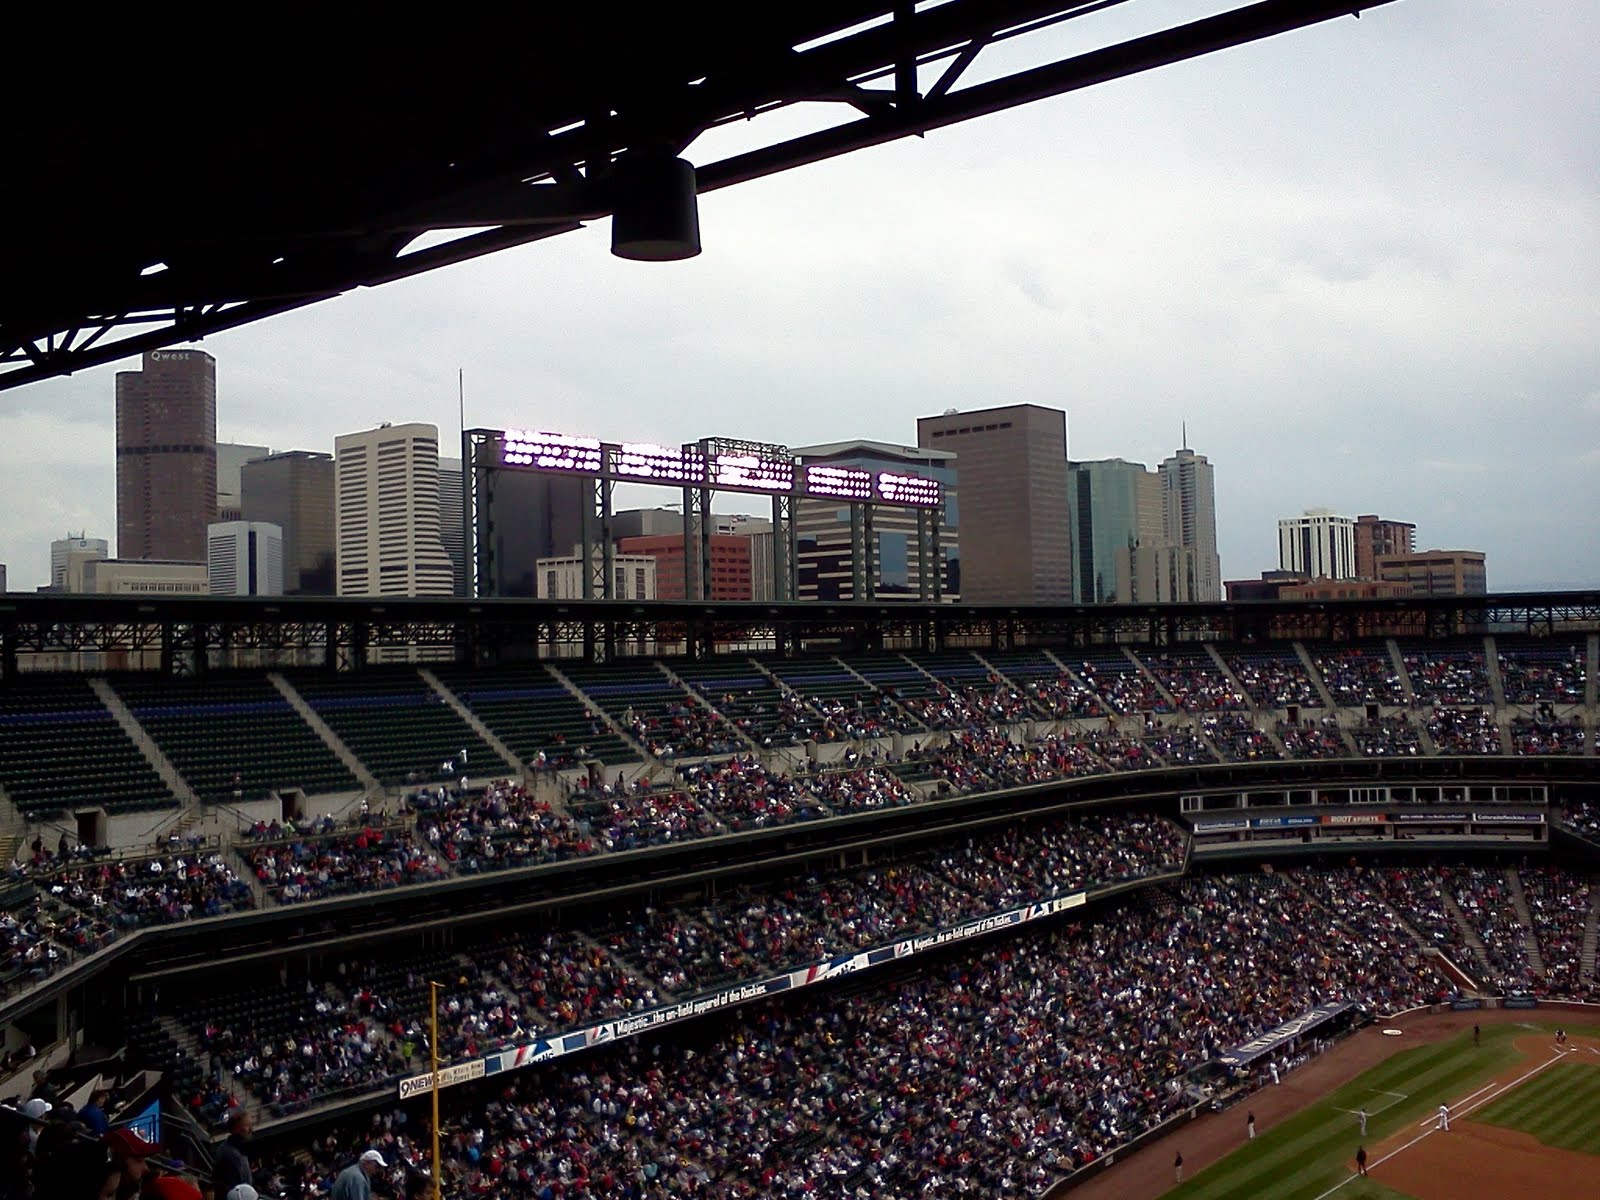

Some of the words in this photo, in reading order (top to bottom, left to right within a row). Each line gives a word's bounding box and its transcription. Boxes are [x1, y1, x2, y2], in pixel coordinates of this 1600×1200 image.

[151, 351, 189, 361] Qwest
[1331, 815, 1353, 824] ROOT
[665, 1001, 694, 1021] on-field
[694, 993, 720, 1015] apparel
[720, 991, 728, 1006] of
[729, 989, 741, 1003] the
